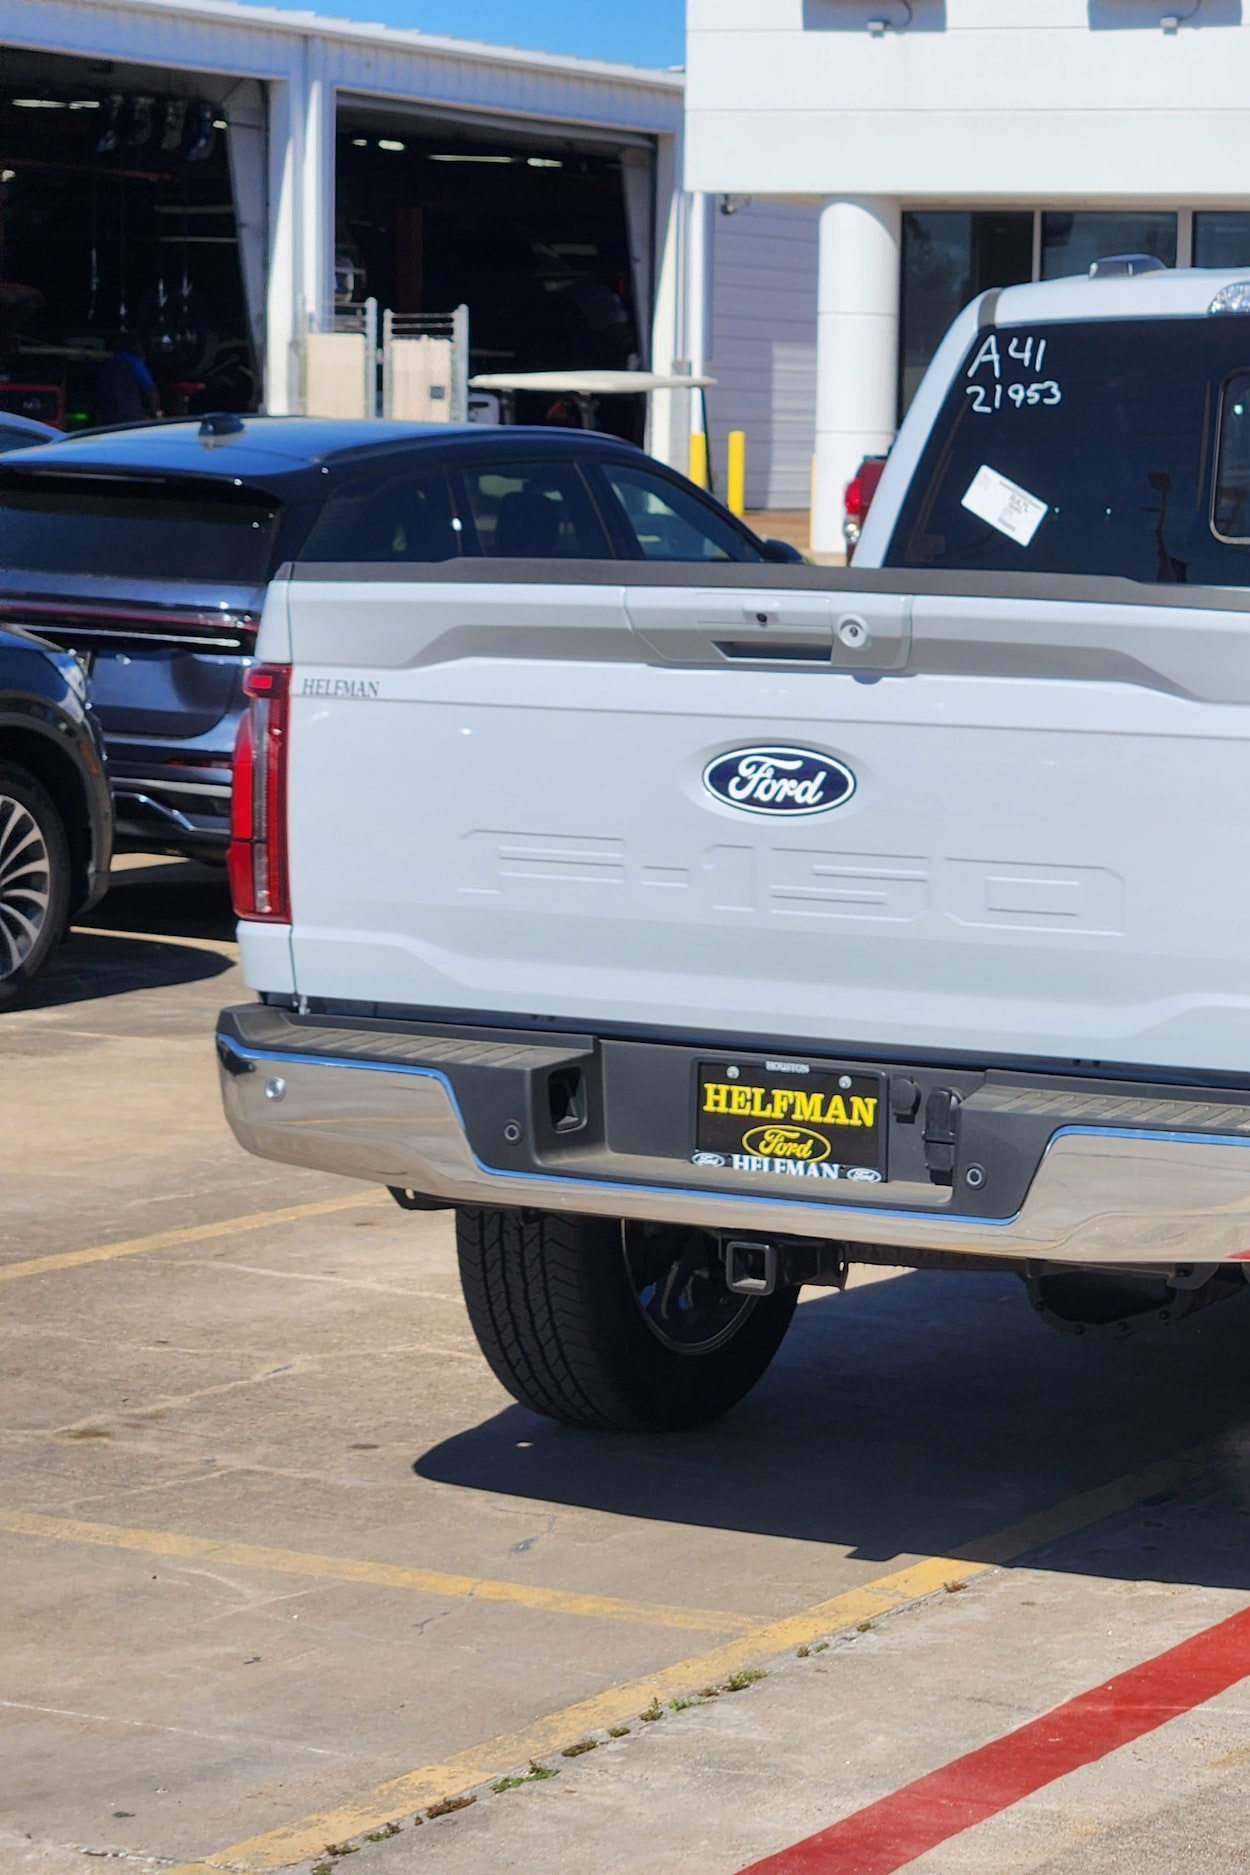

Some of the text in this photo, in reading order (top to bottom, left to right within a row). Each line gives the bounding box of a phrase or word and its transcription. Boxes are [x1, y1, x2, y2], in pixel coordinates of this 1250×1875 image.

[967, 334, 1046, 378] A 41
[966, 380, 1061, 413] 21953
[302, 677, 380, 697] HELFMAN
[728, 755, 827, 804] Ford
[765, 1060, 810, 1073] HOUSTON
[703, 1083, 877, 1127] HELFMAN
[759, 1129, 814, 1159] Ford
